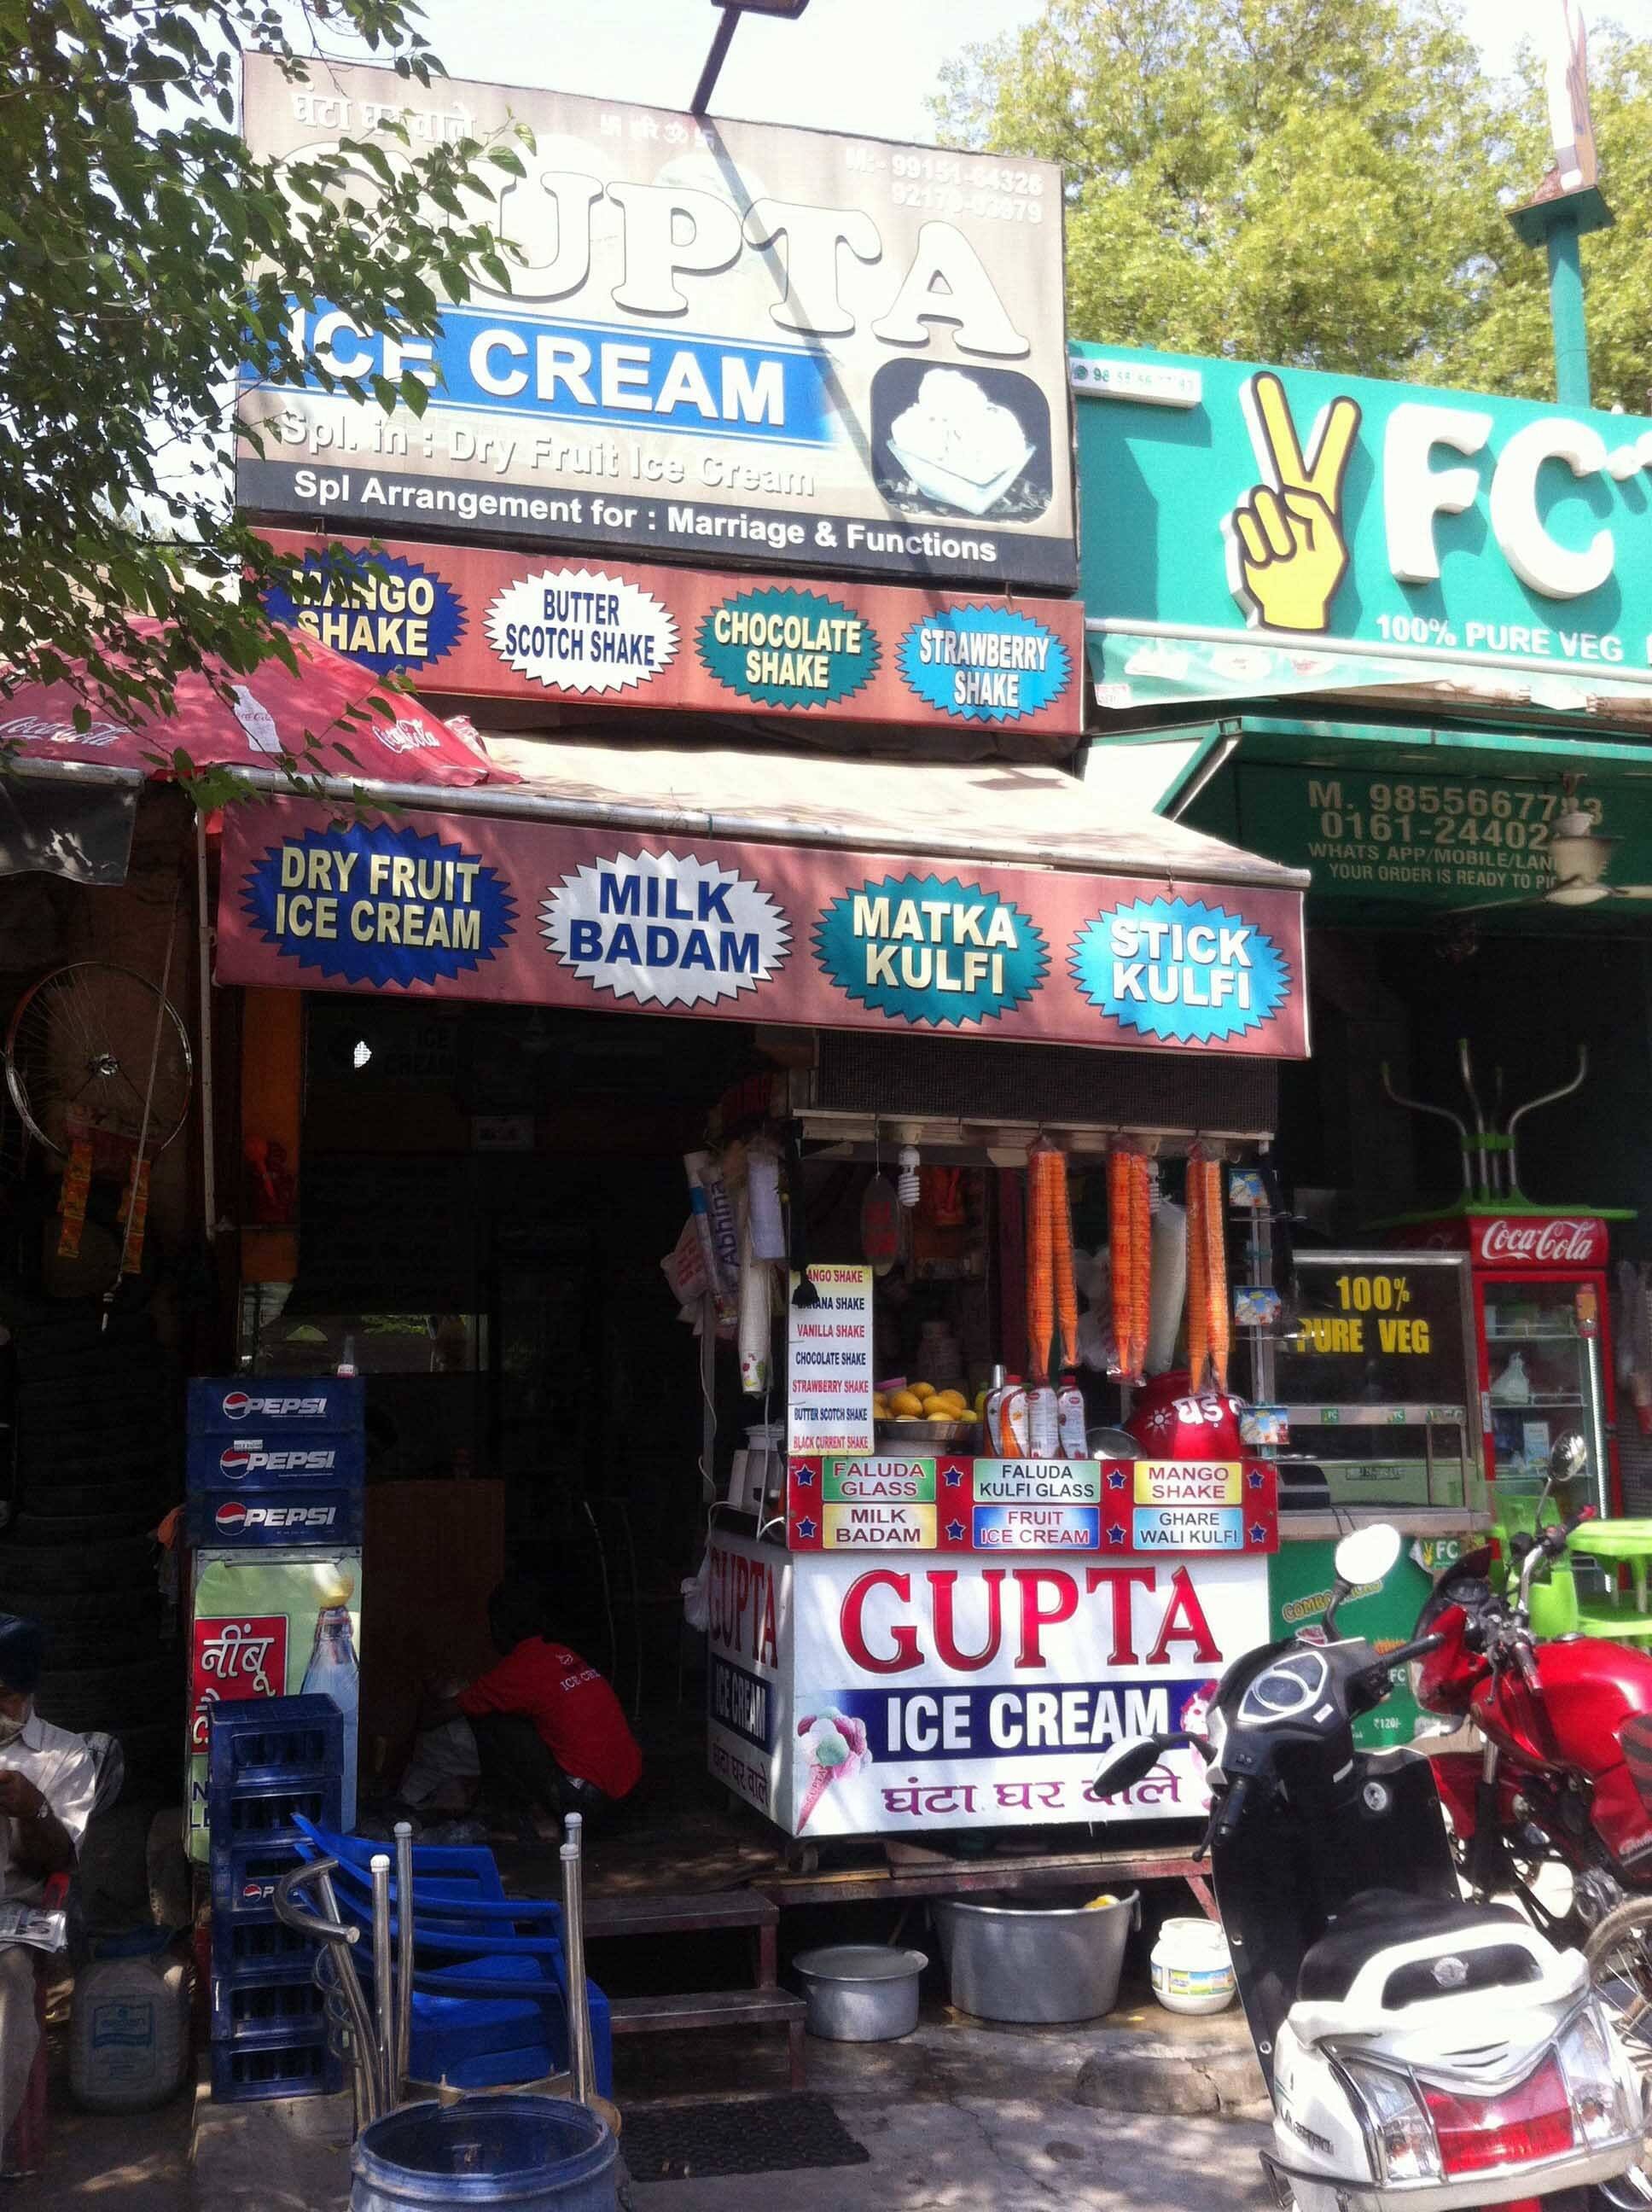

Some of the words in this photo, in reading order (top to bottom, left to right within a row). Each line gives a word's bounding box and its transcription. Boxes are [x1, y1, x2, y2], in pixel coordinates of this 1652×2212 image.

[287, 306, 437, 387] ICE
[468, 329, 785, 427] CREAM
[281, 410, 358, 455] Spl.
[373, 418, 409, 457] in
[449, 430, 516, 474] Dry
[530, 437, 620, 478] Fruit
[629, 443, 685, 485] Ice
[700, 455, 816, 498] Cream
[294, 469, 350, 507] Spl
[361, 478, 582, 526] Arrangement
[591, 498, 637, 527] for
[648, 509, 656, 531] :
[667, 507, 806, 549] Marriage
[815, 520, 838, 548] &
[847, 525, 998, 563] Functions
[544, 589, 619, 626] BUTTER
[298, 611, 428, 656] SHAKE
[505, 624, 583, 661] SCOTCH
[590, 631, 654, 667] SHAKE
[714, 610, 862, 655] CHOCOLATE
[1377, 614, 1457, 648] 100%
[1466, 622, 1551, 655] PURE
[1559, 631, 1624, 662] VEG
[919, 628, 1049, 672] STRAWBERRY
[745, 651, 829, 690] SHAKE
[953, 674, 1019, 708] SHAKE
[1308, 780, 1354, 810] M.
[1308, 842, 1380, 861] WHATS
[281, 846, 358, 894] DRY
[369, 854, 480, 903] FRUIT
[1329, 863, 1373, 882] YOUR
[1378, 864, 1432, 883] ORDER
[1437, 867, 1451, 884] IS
[1457, 867, 1507, 888] READY
[1511, 873, 1530, 889] TO
[599, 872, 735, 925] MILK
[275, 894, 338, 939] ICE
[349, 899, 480, 951] CREAM
[852, 894, 1019, 951] MATKA
[568, 919, 759, 975] BADAM
[1109, 918, 1253, 968] STICK
[865, 943, 1004, 995] KULFI
[1112, 963, 1252, 1010] KULFI
[1481, 1220, 1597, 1261] Coca-Cola
[807, 1270, 831, 1283] ANGO
[834, 1270, 864, 1284] SHAKE
[1335, 1276, 1411, 1312] 100%
[835, 1297, 865, 1311] SHAKE
[797, 1324, 834, 1338] VANILLA
[835, 1324, 865, 1338] SHAKE
[1296, 1318, 1364, 1353] PURE
[1378, 1318, 1430, 1354] VEG
[795, 1352, 840, 1365] CHOCOLATE
[841, 1352, 866, 1366] SHAKE
[792, 1380, 842, 1394] STRAWBERRY
[844, 1380, 869, 1394] SHAKE
[246, 1398, 328, 1414] PEPSI
[794, 1408, 819, 1421] BUTTER
[820, 1408, 845, 1421] SCOTCH
[846, 1408, 868, 1421] SHAKE
[794, 1436, 814, 1449] BLACK
[815, 1436, 846, 1449] CURRENT
[847, 1436, 869, 1449] SHAKE
[247, 1451, 335, 1470] PEPSI
[834, 1463, 926, 1478] FALUDA
[1002, 1464, 1073, 1479] FALUDA
[1149, 1467, 1230, 1481] MANGO
[841, 1481, 917, 1497] GLASS
[980, 1482, 1030, 1496] KULFI
[1036, 1483, 1094, 1498] GLASS
[1152, 1485, 1225, 1499] SHAKE
[243, 1507, 337, 1527] PEPSI
[851, 1509, 906, 1523] MILK
[1009, 1511, 1064, 1525] FRUIT
[1159, 1512, 1220, 1526] GHARE
[835, 1528, 922, 1543] BADAM
[981, 1529, 1013, 1543] ICE
[1020, 1529, 1090, 1544] CREAM
[1140, 1530, 1184, 1543] WALI
[1190, 1529, 1237, 1544] KULFI
[709, 1546, 778, 1670] GUPTA
[840, 1565, 1224, 1674] GUPTA
[887, 1693, 970, 1752] ICE
[989, 1688, 1169, 1747] CREAM
[881, 1776, 980, 1817] घंटा
[993, 1780, 1067, 1811] घर
